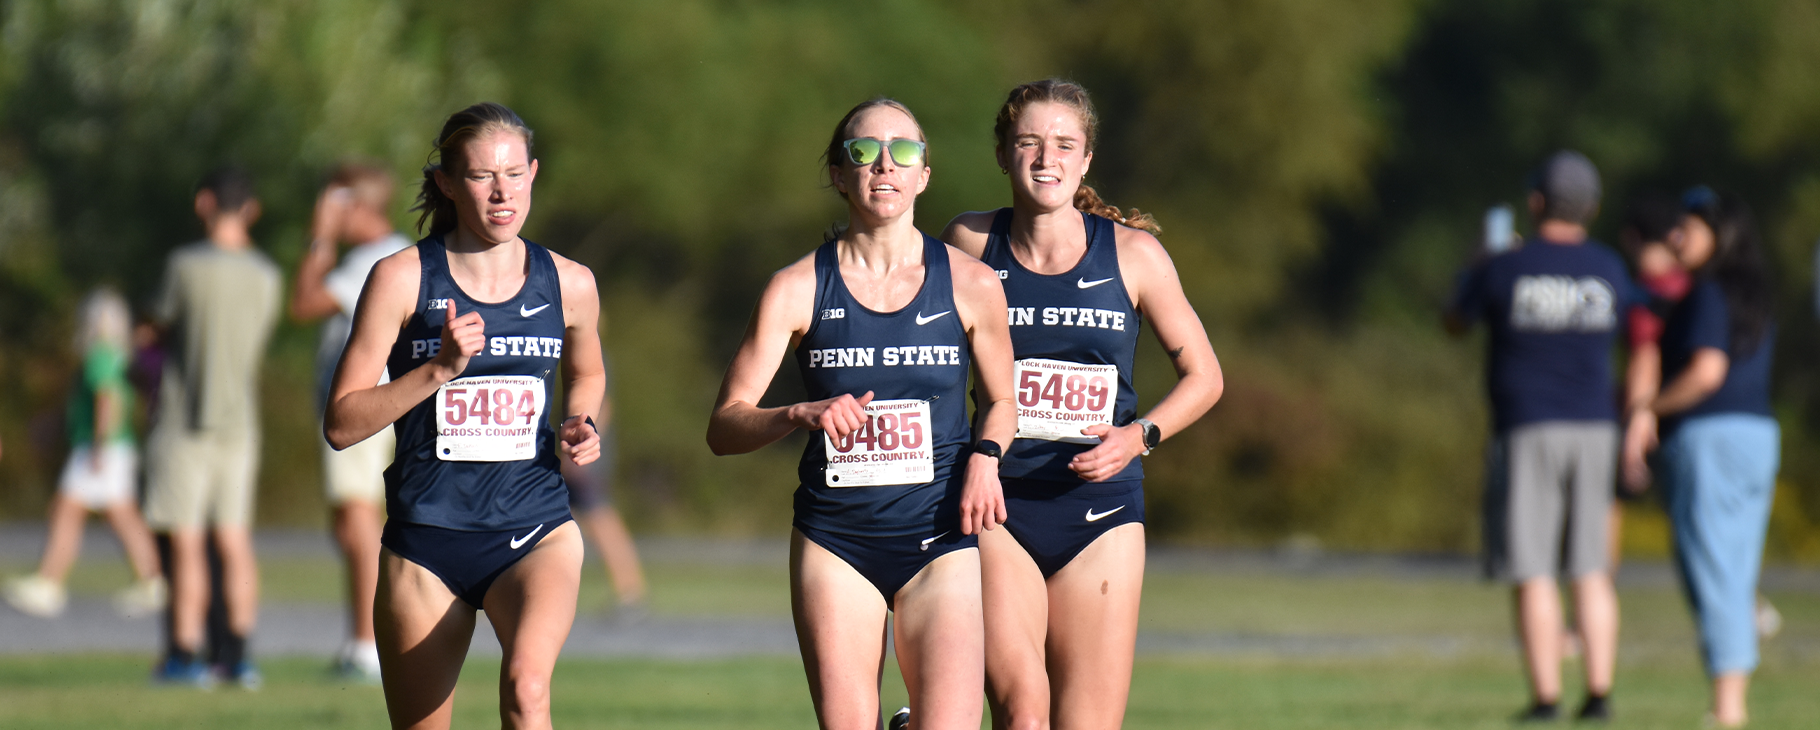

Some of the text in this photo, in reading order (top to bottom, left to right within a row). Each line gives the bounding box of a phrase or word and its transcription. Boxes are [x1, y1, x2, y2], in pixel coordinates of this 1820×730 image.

[1042, 307, 1126, 331] STATE
[490, 336, 563, 359] STATE
[809, 346, 960, 368] PENN STATE
[1042, 363, 1066, 371] HAVEN
[1067, 365, 1108, 373] UNIVERSITY
[1018, 370, 1108, 412] 5489
[445, 388, 536, 426] 5484
[875, 402, 919, 411] UNIVERSITY
[1055, 411, 1106, 422] COUNTRY
[443, 427, 532, 437] CROSS COUNTRY
[832, 454, 869, 464] CROSS
[871, 451, 925, 462] COUNTRY
